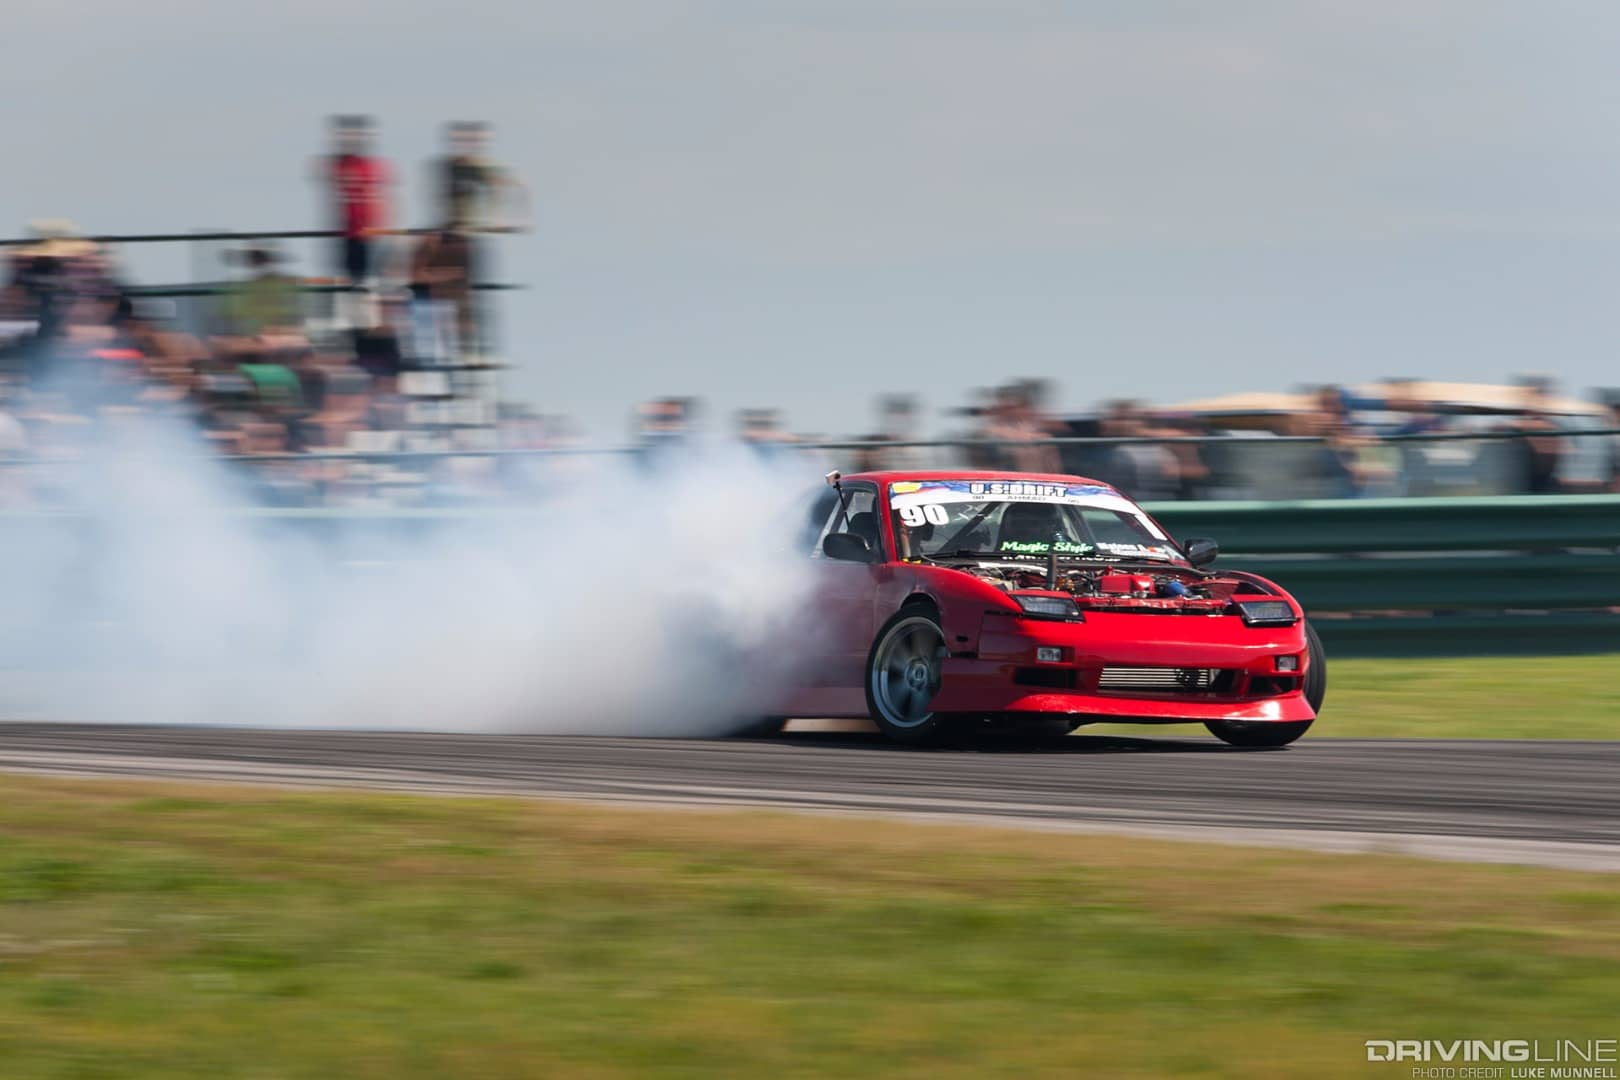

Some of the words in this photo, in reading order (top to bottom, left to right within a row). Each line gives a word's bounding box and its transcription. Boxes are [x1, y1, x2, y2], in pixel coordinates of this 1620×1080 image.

[899, 503, 949, 527] 90
[1000, 541, 1050, 553] Magic
[1053, 541, 1094, 554] Style
